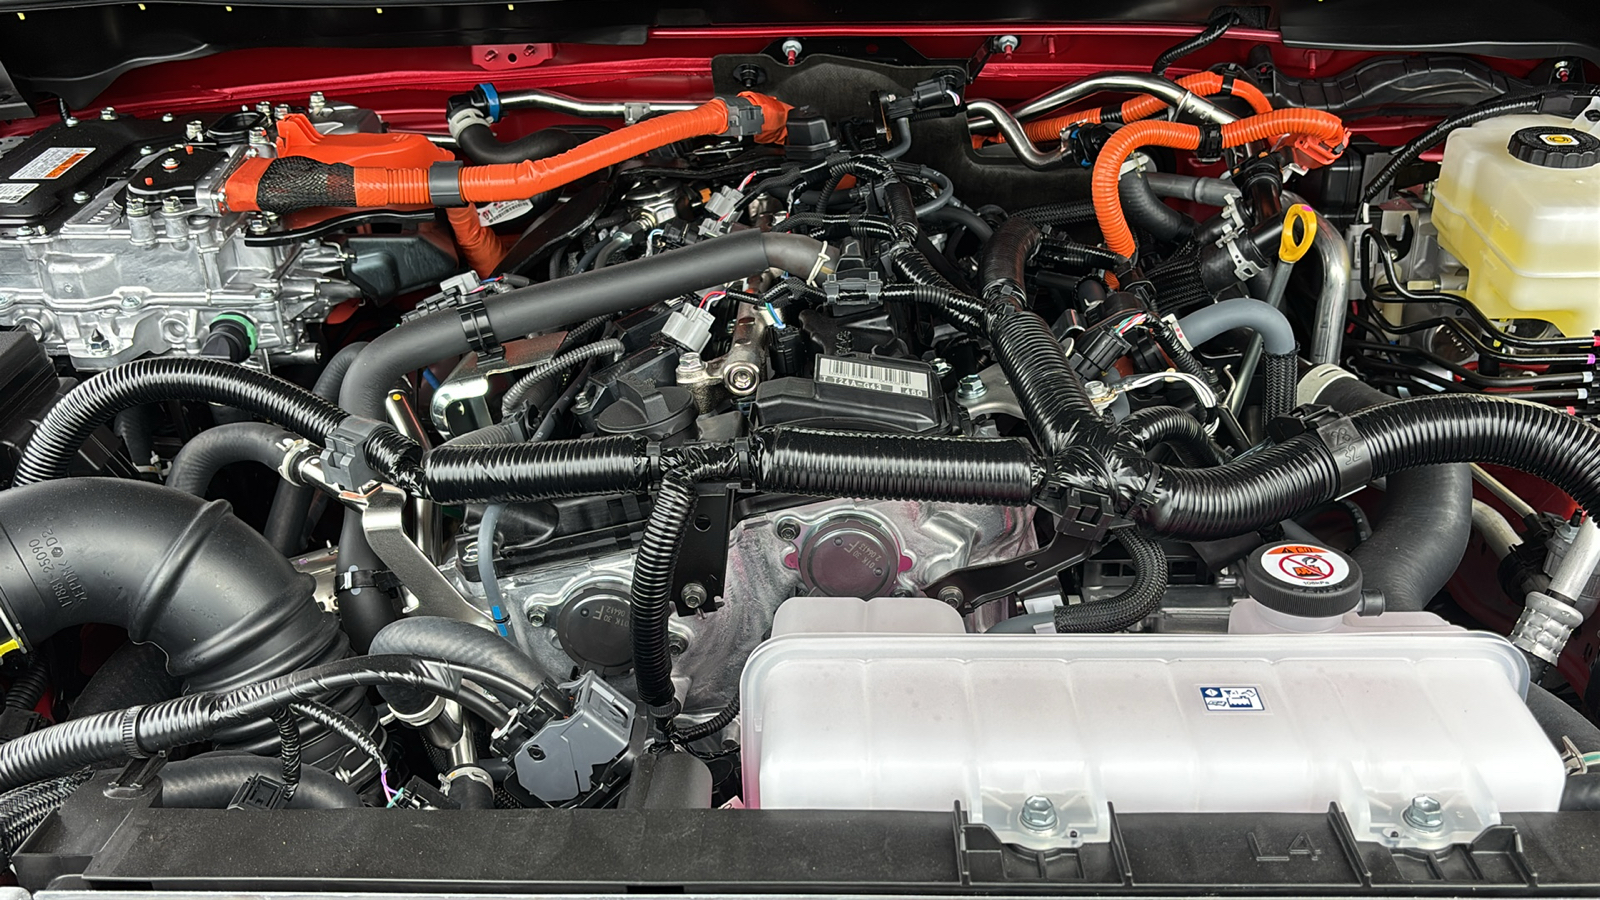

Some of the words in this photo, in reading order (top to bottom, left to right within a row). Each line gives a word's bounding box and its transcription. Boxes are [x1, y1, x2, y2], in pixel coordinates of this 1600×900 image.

[833, 377, 882, 391] T24A-G43
[1345, 444, 1362, 466] 32
[42, 528, 58, 547] D2
[843, 540, 860, 554] F
[592, 605, 605, 620] F
[1246, 831, 1322, 862] L4
